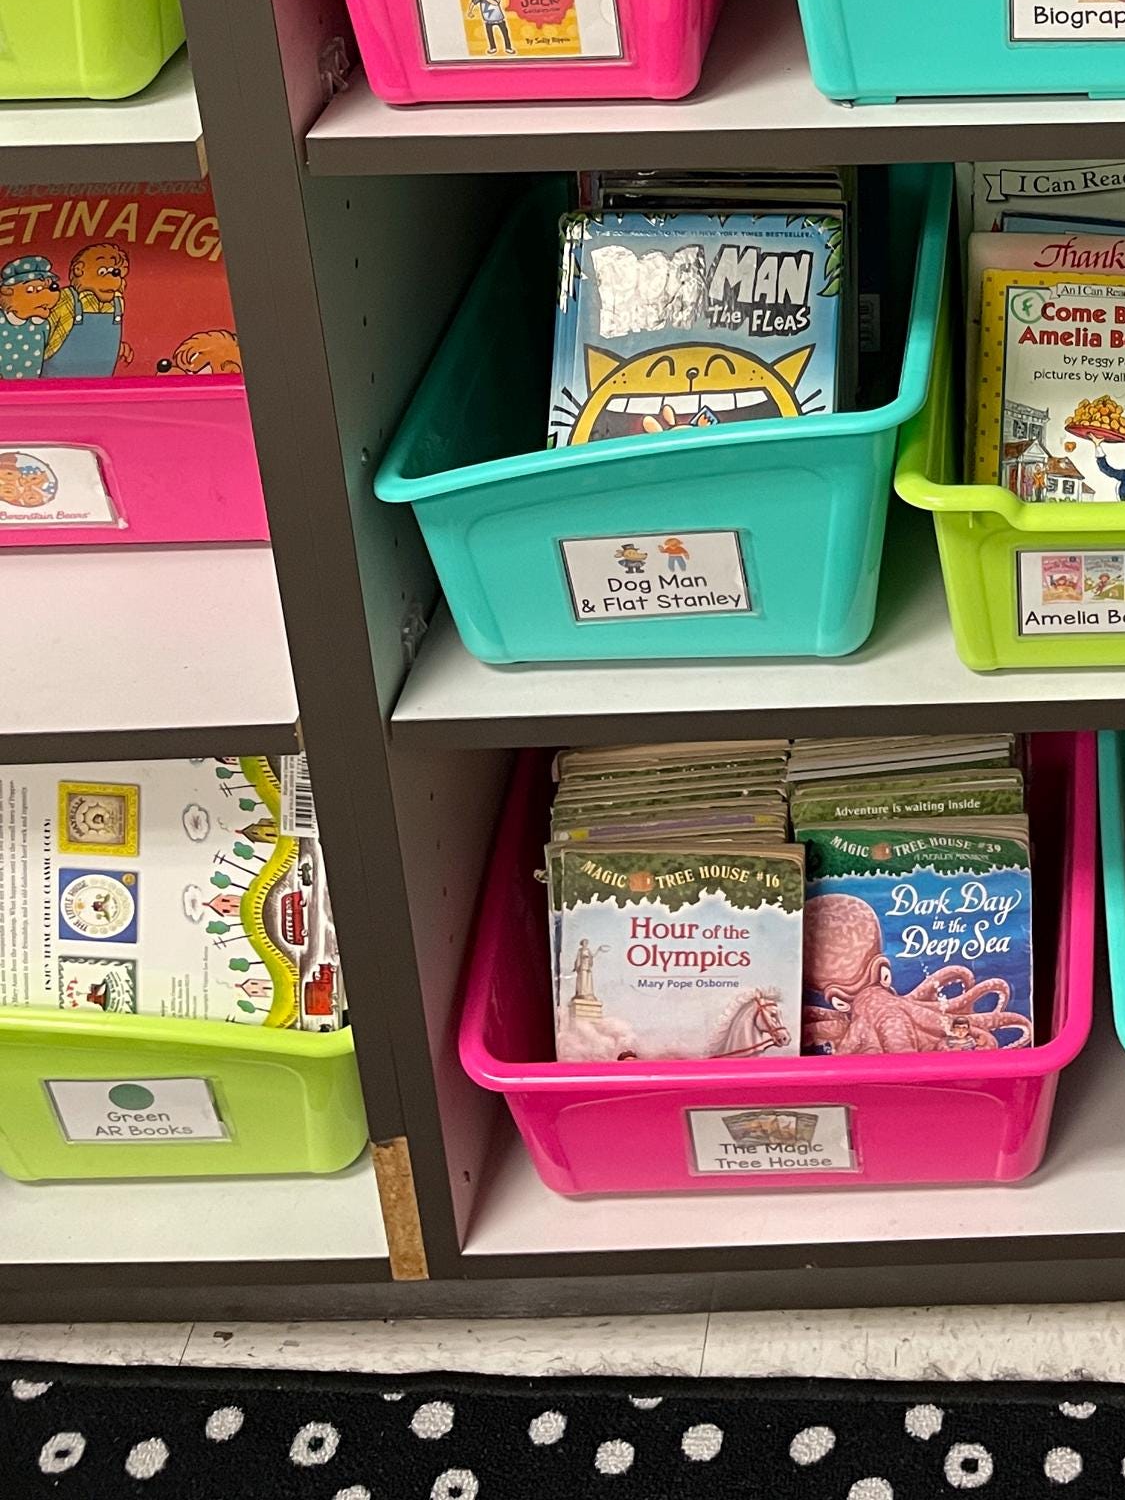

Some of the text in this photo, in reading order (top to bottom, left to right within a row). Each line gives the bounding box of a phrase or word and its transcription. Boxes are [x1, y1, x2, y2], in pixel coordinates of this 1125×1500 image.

[1018, 175, 1027, 193] I
[1033, 176, 1075, 194] Can
[709, 246, 813, 306] MAN
[1061, 285, 1077, 295] An
[1078, 285, 1082, 295] I
[1083, 286, 1103, 296] Can
[1041, 302, 1107, 323] Come
[1018, 326, 1102, 348] Amelia
[1063, 354, 1078, 365] by
[1081, 355, 1115, 367] Peggy
[1033, 369, 1080, 381] pictures
[1085, 371, 1099, 383] by
[56, 510, 90, 520] Bears
[607, 574, 707, 593] Dog Man
[581, 592, 741, 613] & Flat Stanley
[1025, 610, 1099, 625] Amelia
[834, 799, 981, 817] Adventure is waiting inside
[830, 835, 869, 858] MAGIC
[893, 838, 926, 857] TREE
[928, 837, 971, 852] HOUSE
[580, 860, 780, 890] MAGIC TREE HOUSE #16
[885, 881, 1022, 925] Dark Day
[629, 916, 751, 940] Hour of the
[932, 915, 967, 934] in the
[895, 919, 1011, 963] Deep Sea
[627, 944, 751, 973] Olympics
[637, 977, 739, 990] Mary Pope Osborne
[107, 1111, 171, 1123] Green
[95, 1124, 193, 1136] AR Books
[720, 1142, 825, 1156] The Magic
[714, 1156, 833, 1169] Tree House
